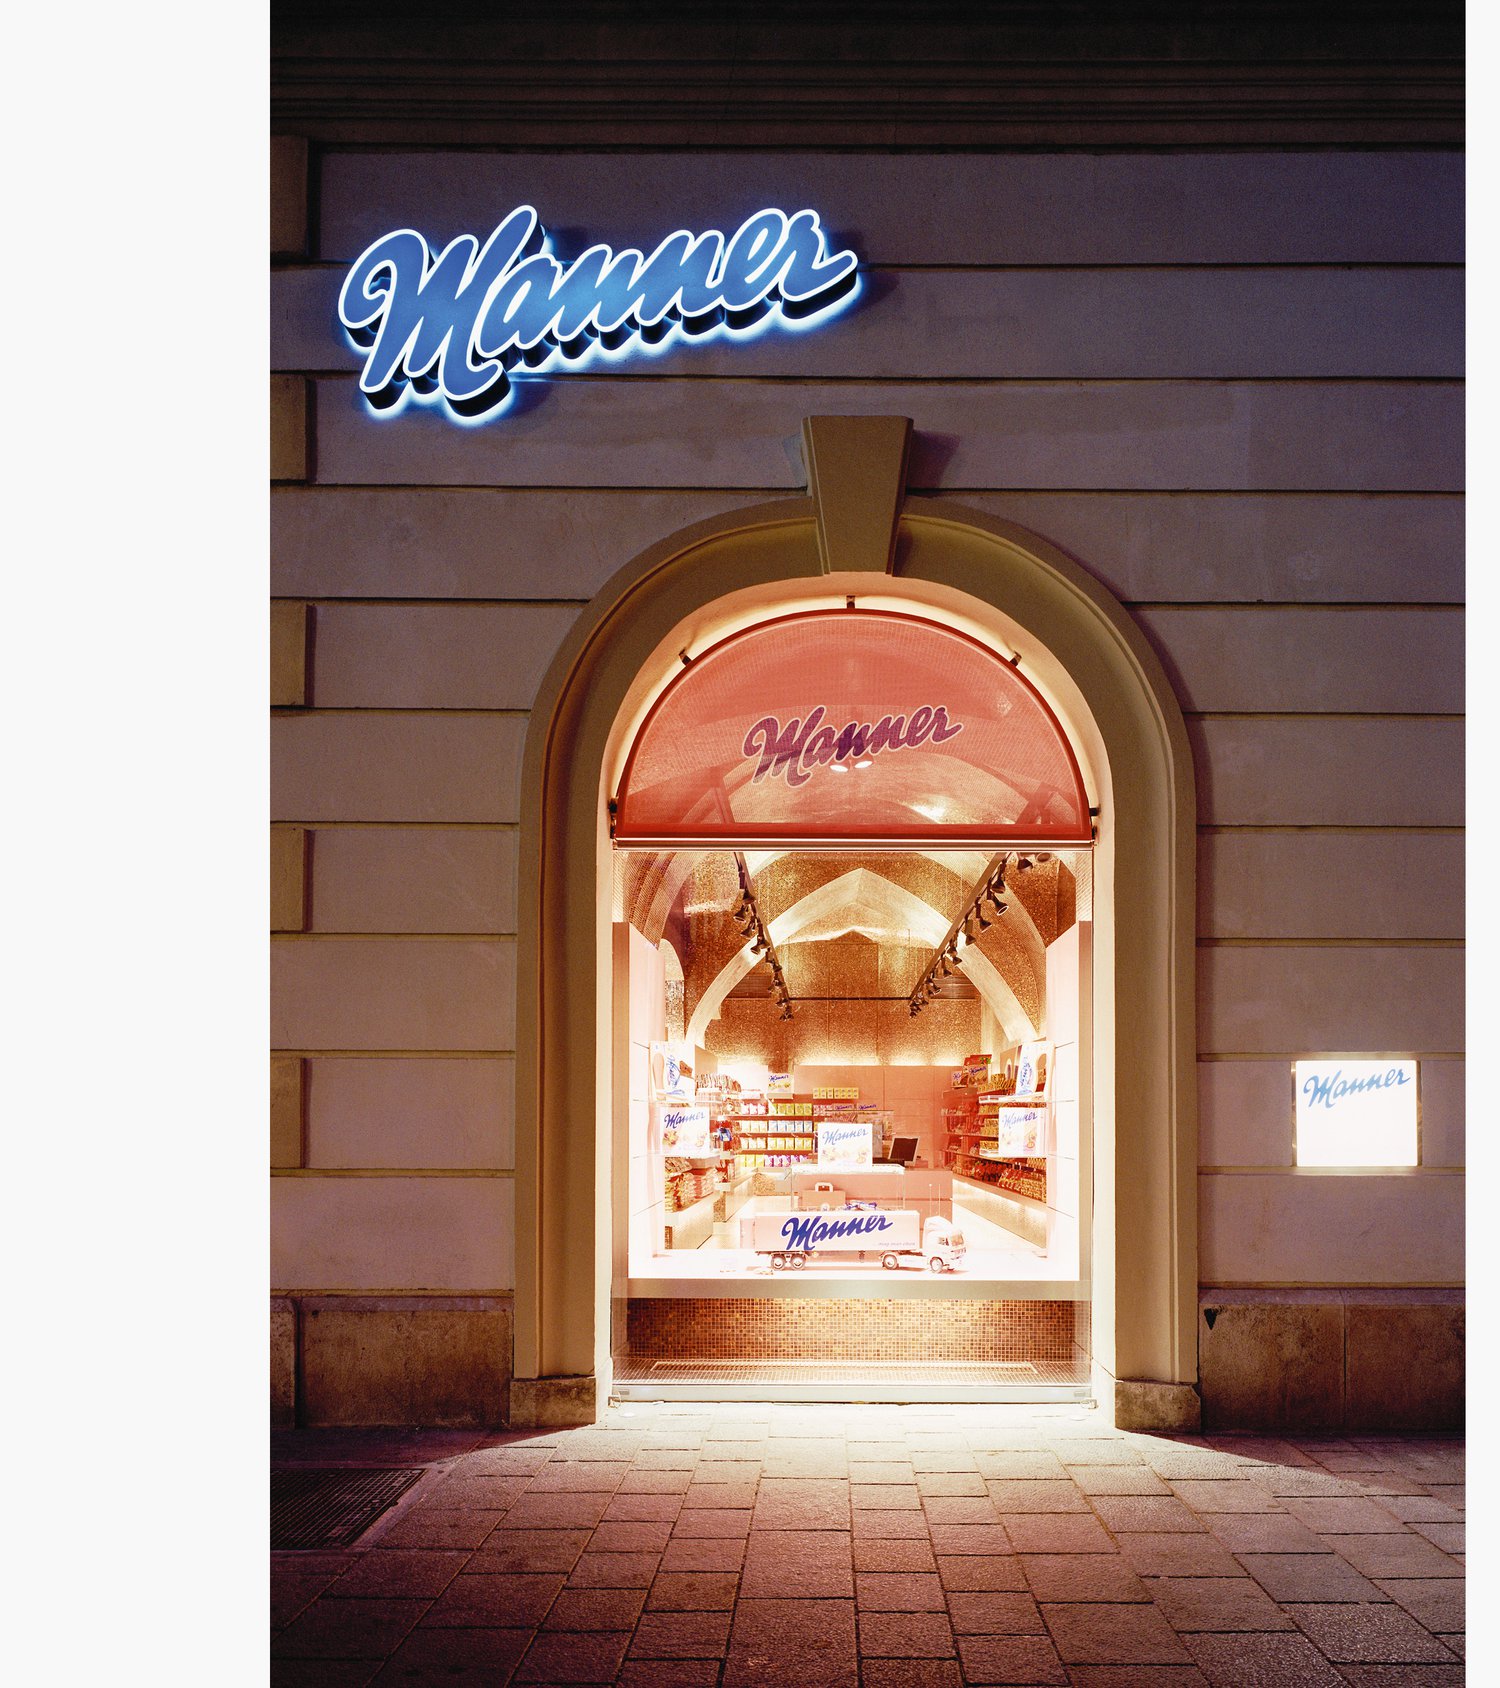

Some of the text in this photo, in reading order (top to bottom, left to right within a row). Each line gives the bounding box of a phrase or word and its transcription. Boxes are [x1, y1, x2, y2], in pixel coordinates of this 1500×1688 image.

[338, 205, 857, 402] Manner
[742, 704, 963, 787] Manner
[1303, 1068, 1411, 1109] Manner
[664, 1111, 705, 1129] Manner
[822, 1128, 867, 1145] Manner
[781, 1215, 893, 1251] Manner
